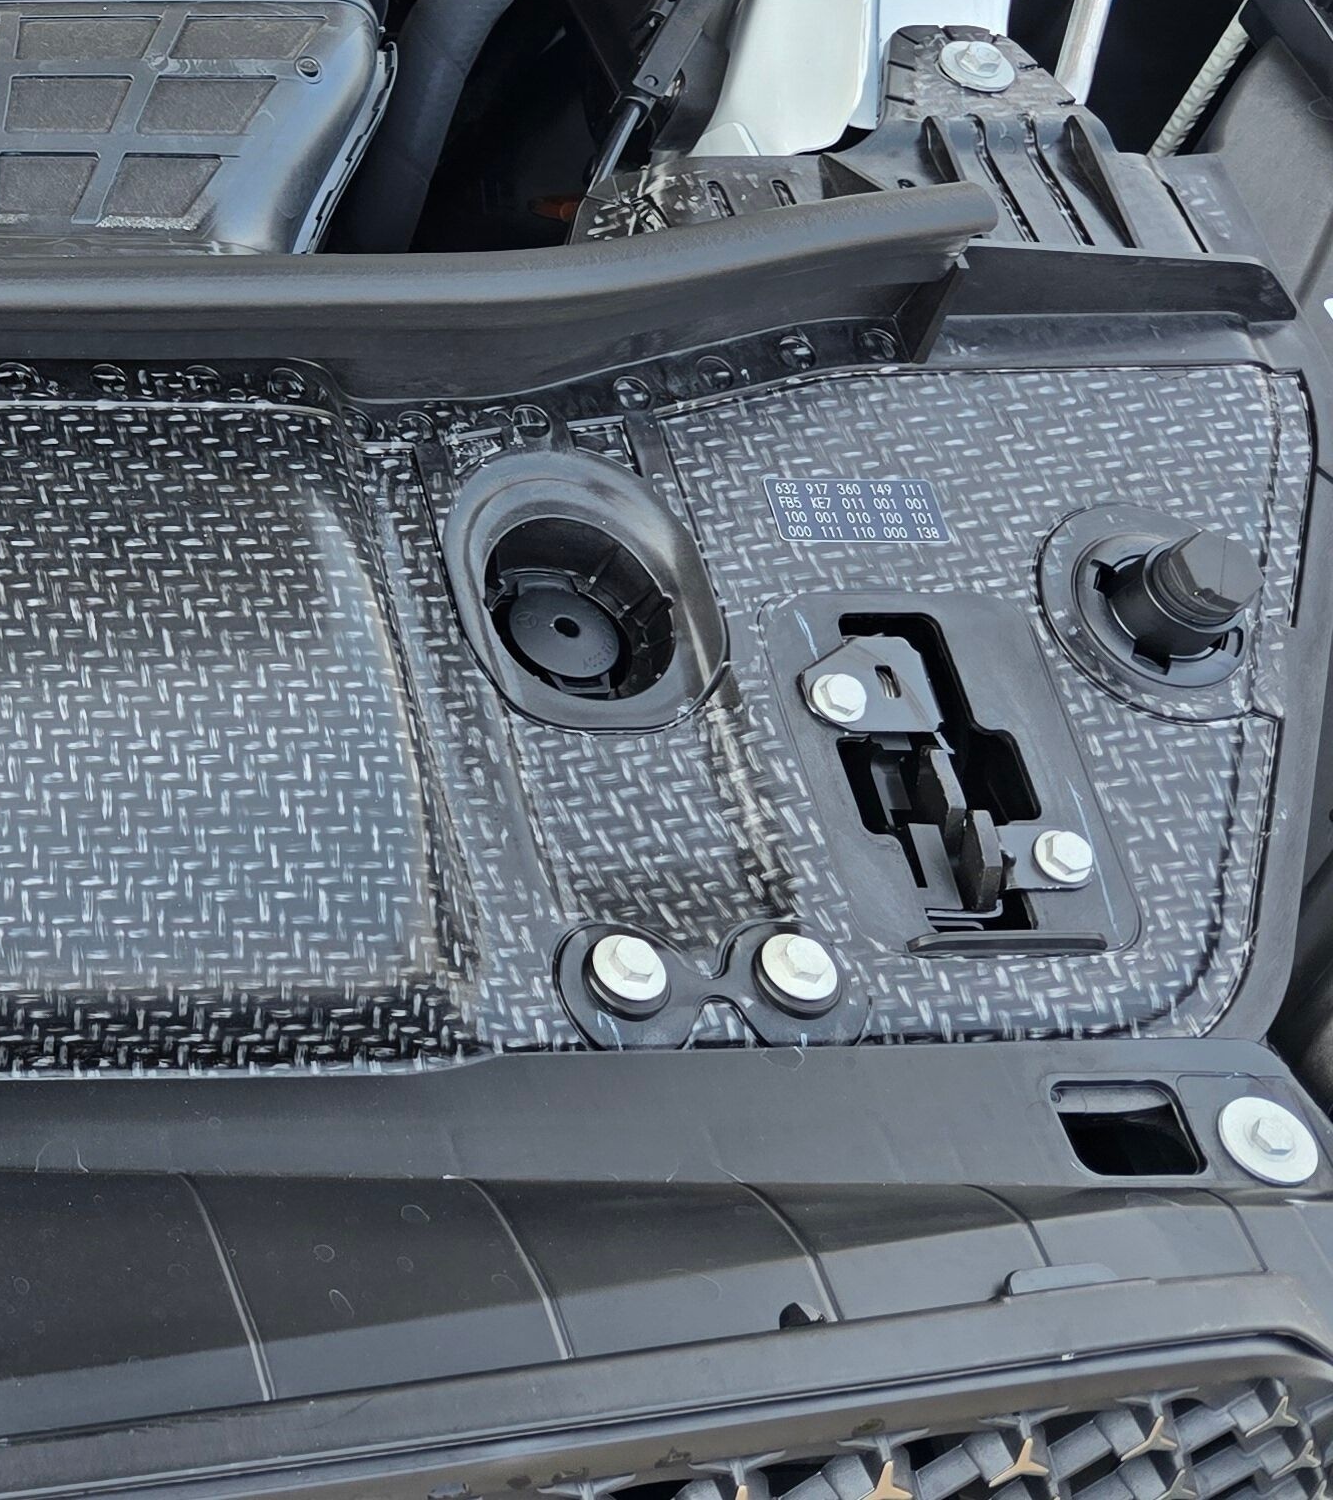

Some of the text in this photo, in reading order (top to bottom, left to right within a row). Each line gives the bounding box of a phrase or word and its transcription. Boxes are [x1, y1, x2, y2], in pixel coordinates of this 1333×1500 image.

[775, 483, 924, 496] 632 917 360 149 111
[779, 497, 928, 510] FB5 KE7 011 001 001
[785, 511, 934, 524] 100 001 010 100 101
[788, 525, 939, 539] 000 111 110 000 138
